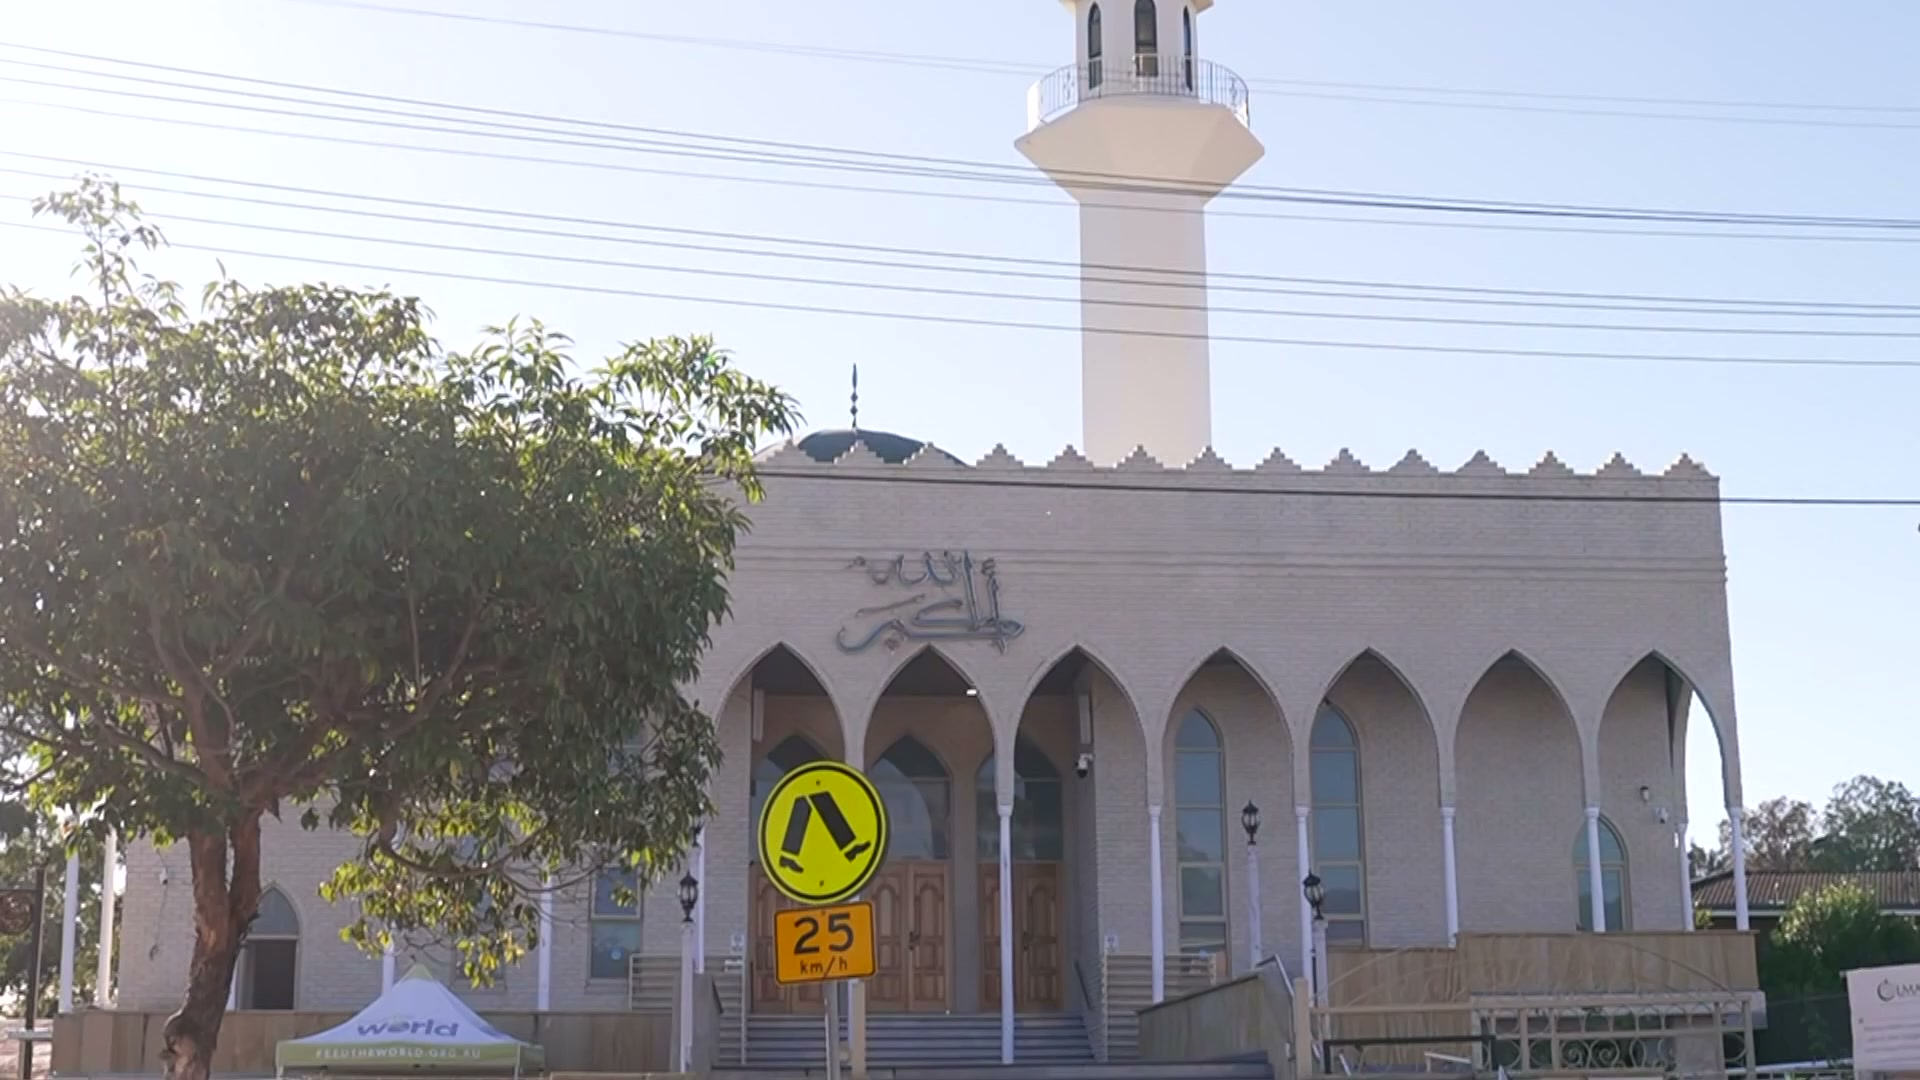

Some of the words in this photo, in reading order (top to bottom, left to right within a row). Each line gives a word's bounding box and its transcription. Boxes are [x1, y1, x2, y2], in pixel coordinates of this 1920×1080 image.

[793, 912, 854, 955] 25
[800, 956, 848, 979] km/h
[357, 1019, 459, 1037] world
